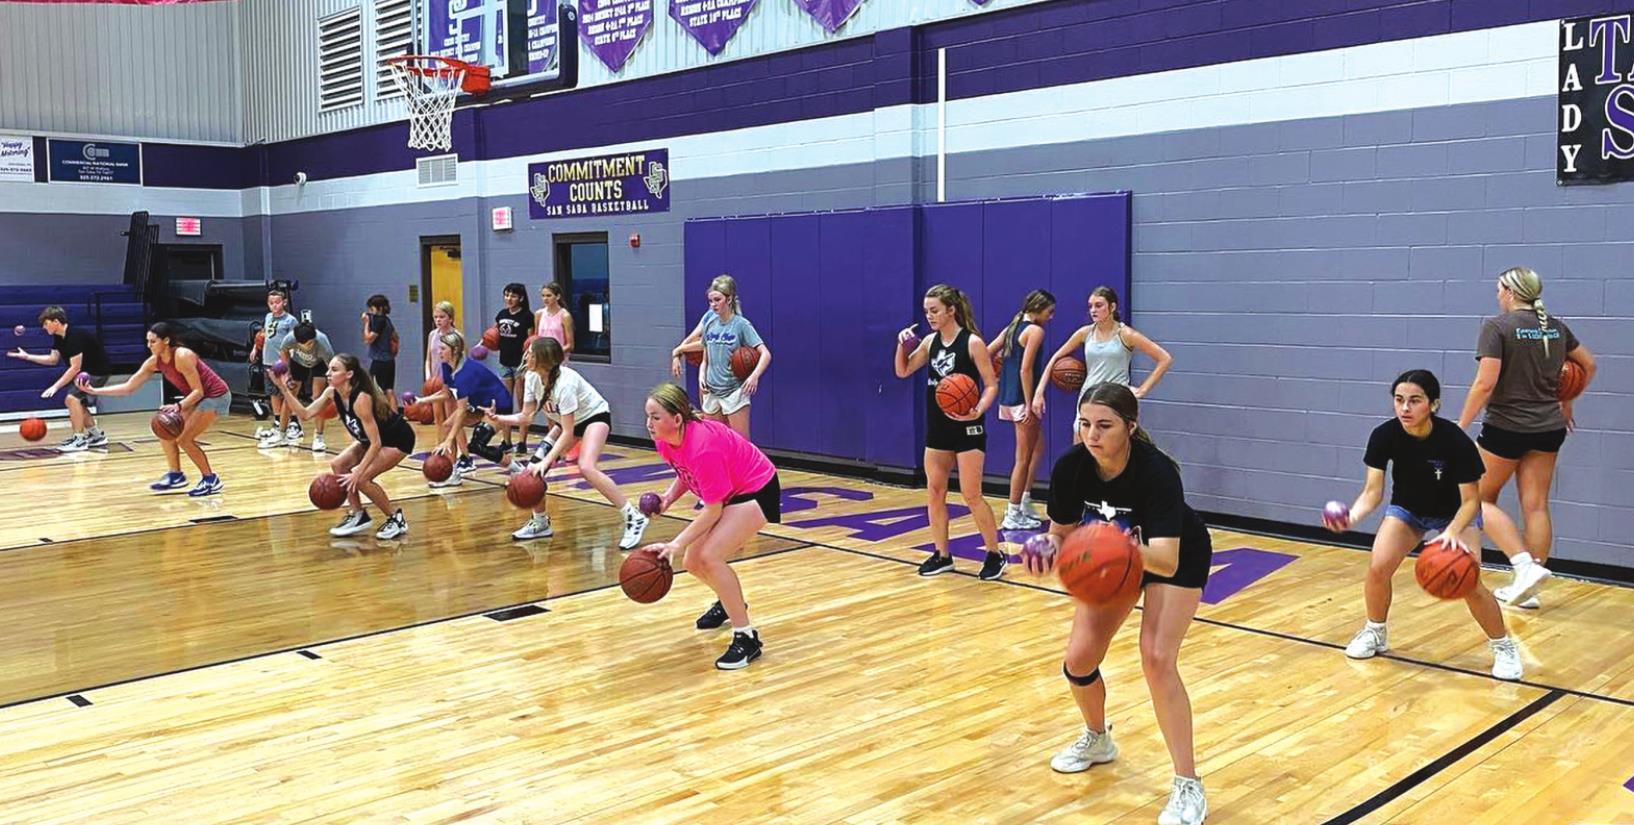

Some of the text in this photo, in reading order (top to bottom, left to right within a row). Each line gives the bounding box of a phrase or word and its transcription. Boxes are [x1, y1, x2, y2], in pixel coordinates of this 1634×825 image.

[627, 14, 643, 27] PLACE
[689, 13, 708, 27] STATE
[722, 7, 741, 20] PLACE
[595, 33, 611, 45] STATE
[620, 28, 637, 40] PLACE
[1560, 22, 1584, 173] LADY
[548, 155, 645, 183] COMMITMENT
[570, 181, 622, 202] COUNTS
[547, 200, 649, 216] SAN SABA BASKETBALL
